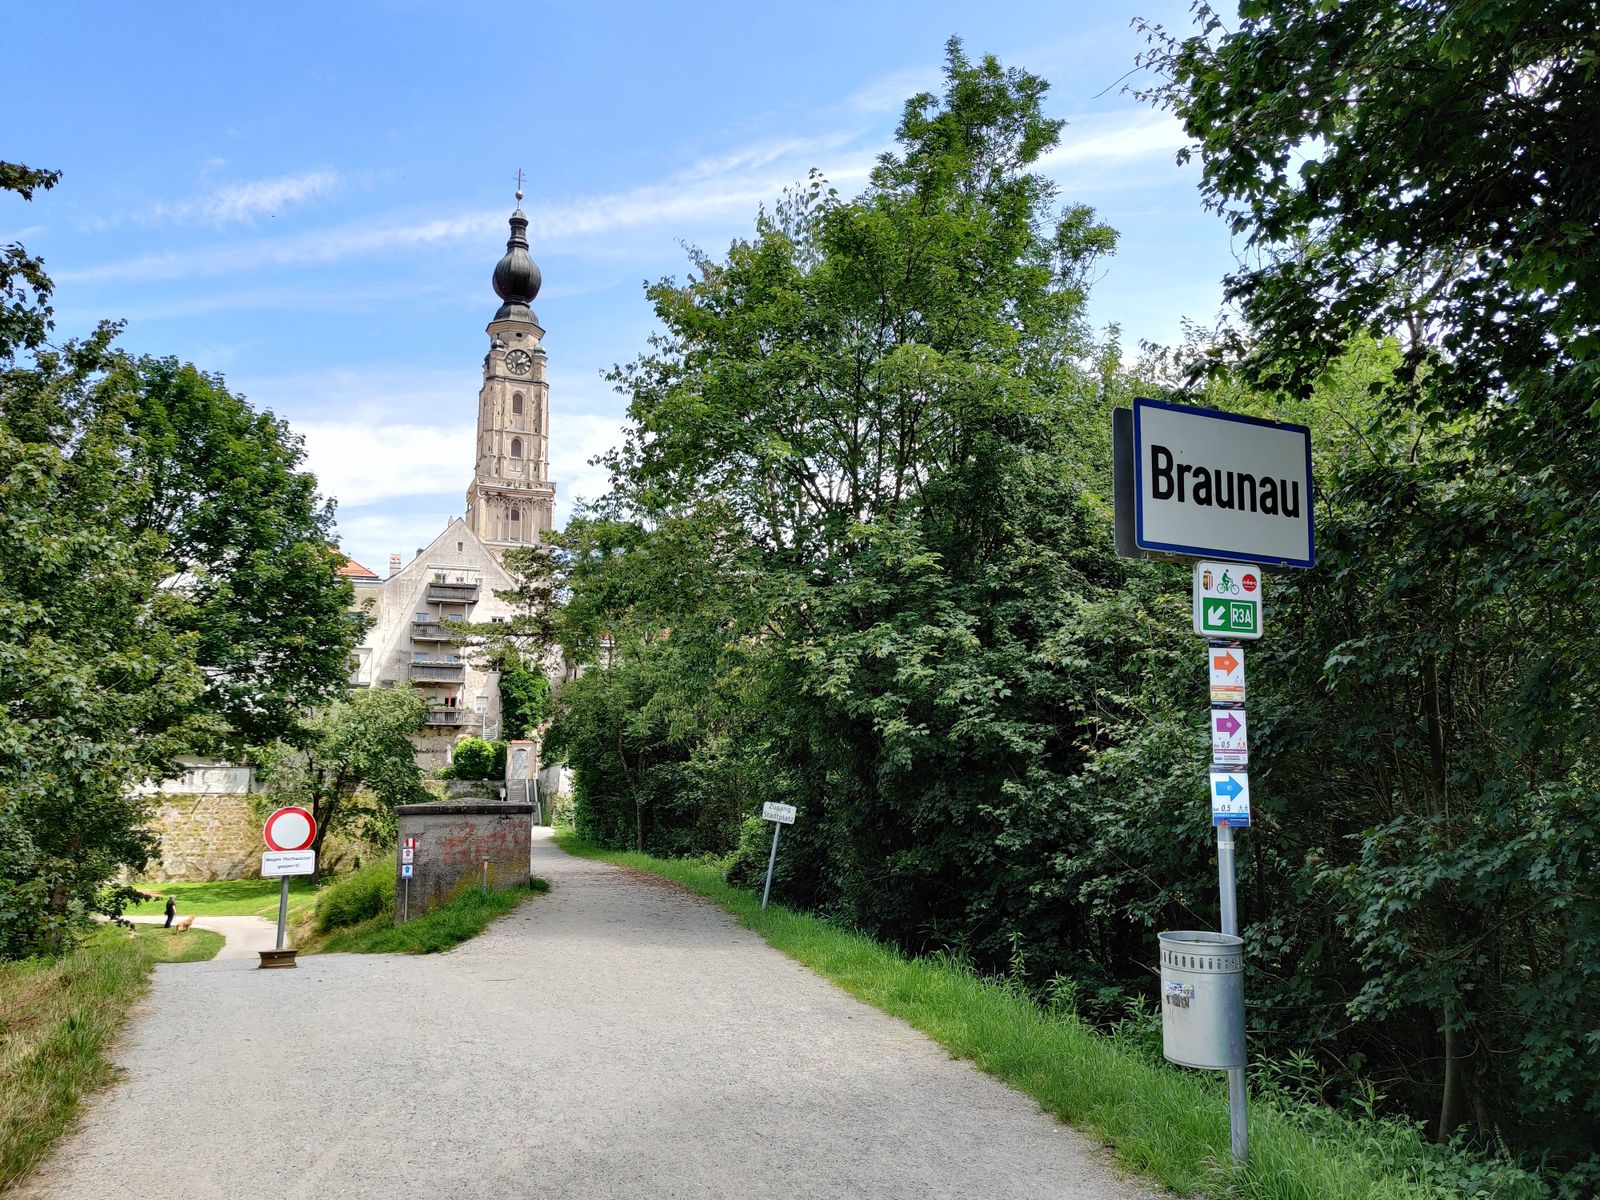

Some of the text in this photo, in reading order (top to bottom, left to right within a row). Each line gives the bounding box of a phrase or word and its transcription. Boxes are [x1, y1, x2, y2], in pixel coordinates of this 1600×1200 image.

[1151, 444, 1300, 518] Braunau
[1232, 607, 1252, 624] R3A
[769, 803, 791, 814] Zugang
[763, 811, 794, 822] Stadtplatz
